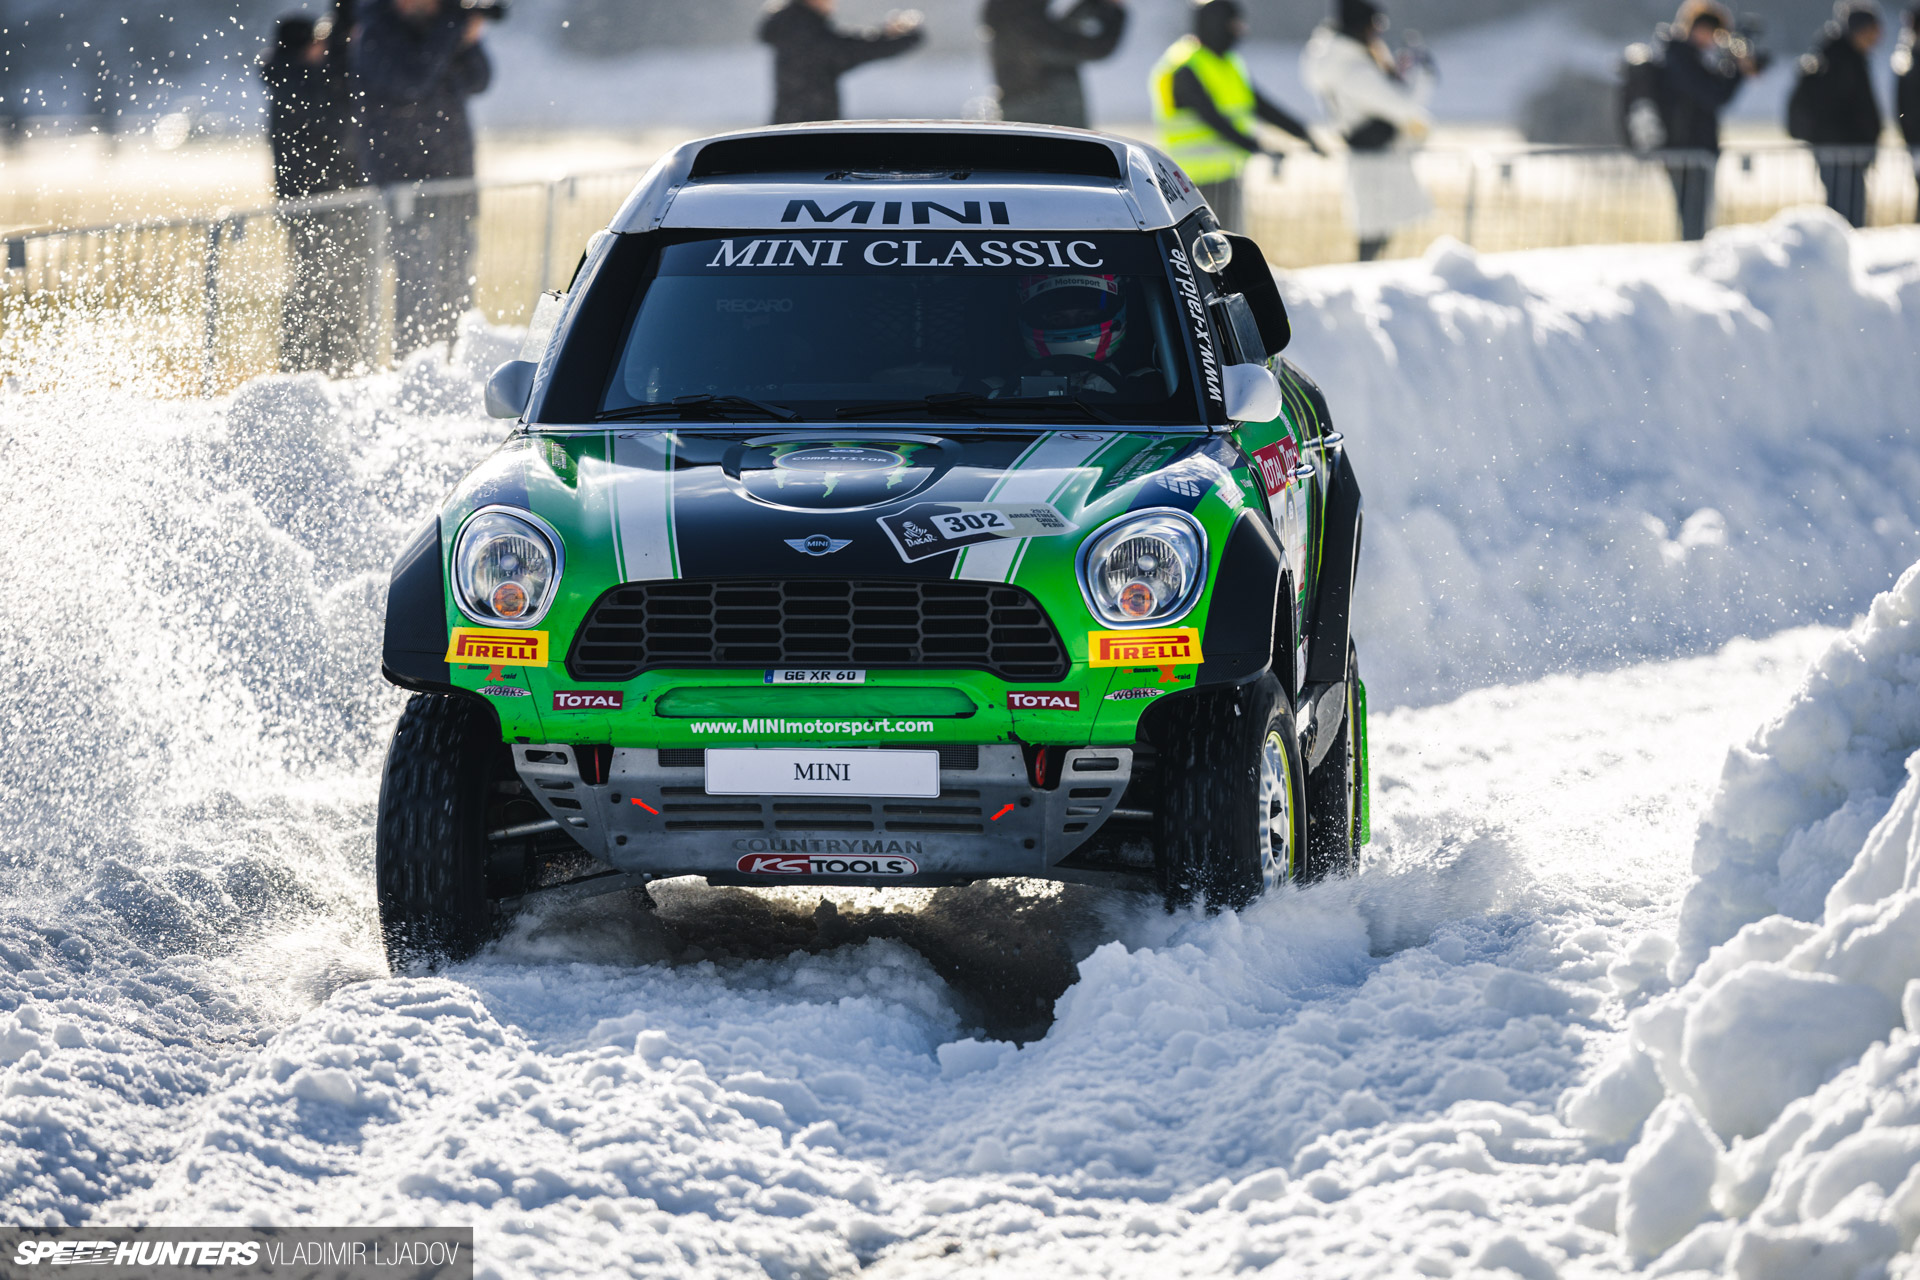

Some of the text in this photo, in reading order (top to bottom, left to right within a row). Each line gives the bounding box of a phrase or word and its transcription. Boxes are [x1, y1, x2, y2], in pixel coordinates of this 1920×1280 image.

[780, 199, 1011, 225] MINI
[706, 239, 1104, 268] MINI CLASSIC
[1054, 278, 1101, 288] Motorsport
[716, 298, 793, 313] RECARO
[1168, 248, 1223, 402] www.x-raid.de
[1254, 454, 1287, 490] TOTAL
[943, 512, 1005, 533] 302
[456, 634, 538, 660] PIRELLI
[1099, 635, 1191, 660] PIRELLI
[784, 671, 806, 681] GG
[809, 671, 831, 681] XR
[836, 671, 857, 681] 60
[482, 685, 525, 697] WORKS
[1112, 688, 1158, 700] WORKS
[555, 693, 621, 707] TOTAL
[1009, 693, 1078, 708] TOTAL
[690, 718, 935, 736] www.MINImotorsport.com
[793, 762, 852, 781] MINI
[732, 838, 923, 854] COUNTRYMAN
[808, 859, 905, 875] TOOLS
